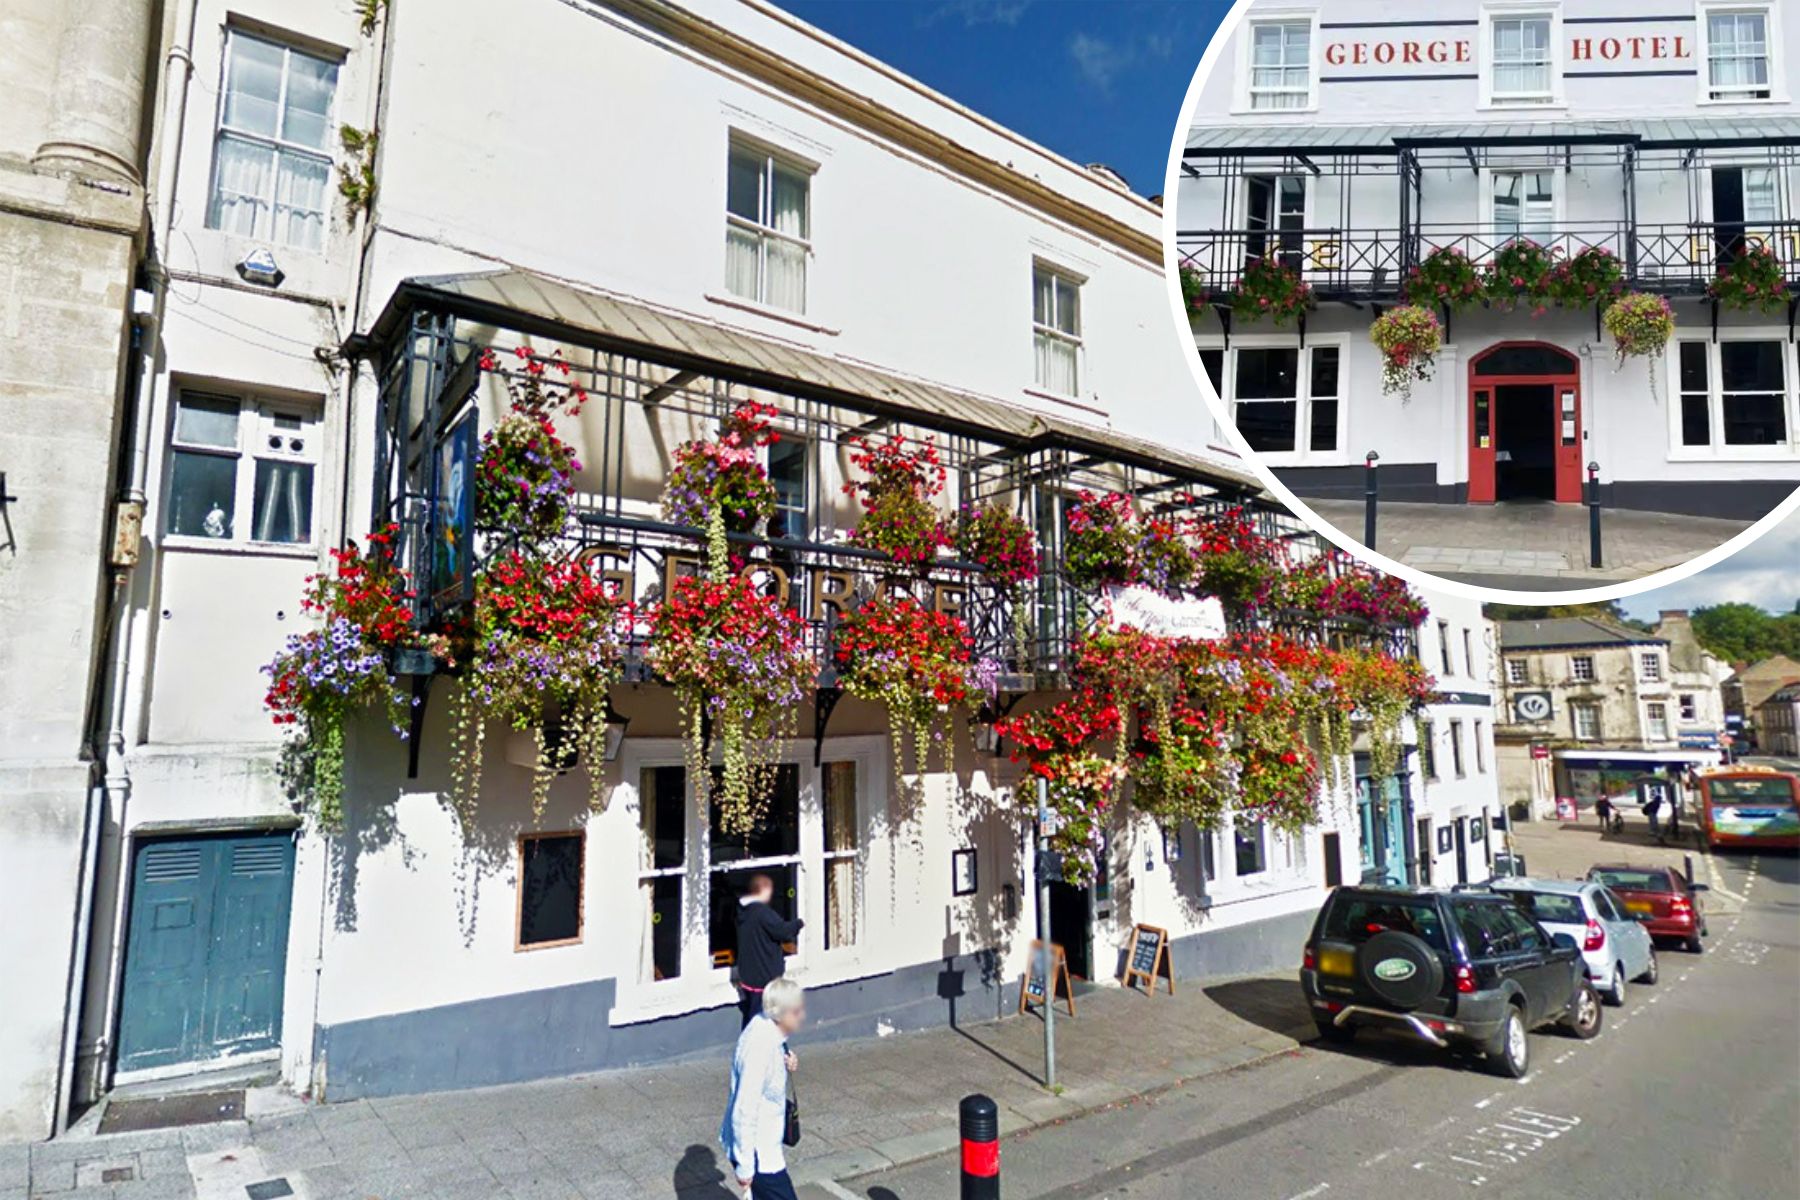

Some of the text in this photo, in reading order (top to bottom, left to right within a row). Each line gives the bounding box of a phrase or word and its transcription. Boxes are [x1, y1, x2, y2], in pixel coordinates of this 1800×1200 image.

[1325, 36, 1691, 65] GEORGE HOTEL
[576, 543, 967, 622] GEORE
